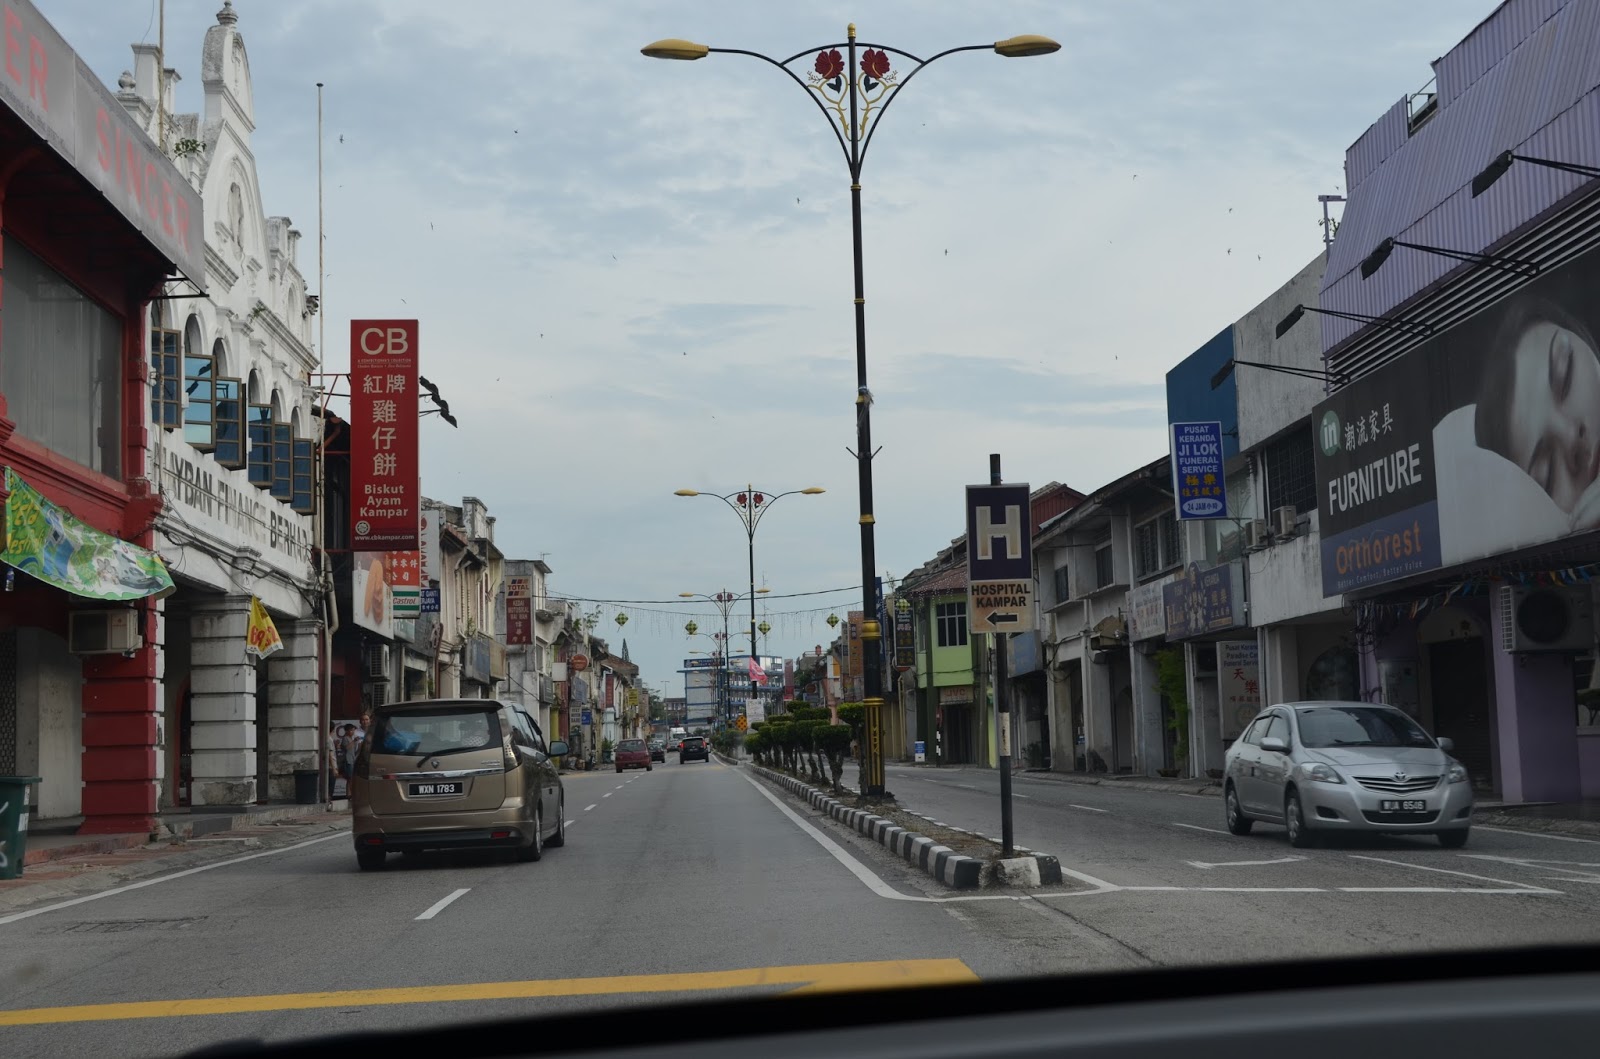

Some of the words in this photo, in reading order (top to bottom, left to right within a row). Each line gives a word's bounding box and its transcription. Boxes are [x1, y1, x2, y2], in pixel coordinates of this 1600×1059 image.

[95, 106, 191, 254] SINGER
[360, 327, 409, 356] CB
[363, 374, 406, 394] 紅牌
[1184, 425, 1209, 434] PUSAT
[1344, 402, 1394, 452] 潮流家具
[1179, 434, 1216, 443] KERANDA
[1178, 444, 1190, 456] JI
[1193, 443, 1219, 456] LOK
[1179, 456, 1219, 465] FUNERAL
[1182, 465, 1218, 474] SERVICE
[1328, 442, 1422, 516] FURNITURE
[364, 484, 404, 494] Biskut
[366, 496, 401, 508] Ayam
[1187, 502, 1194, 511] 24
[359, 507, 409, 519] Kampar
[975, 504, 1022, 560] H
[971, 583, 1031, 596] HOSPITAL
[393, 597, 416, 605] Castrol
[976, 596, 1027, 609] KAMPAR
[418, 784, 434, 794] WXN
[436, 784, 455, 793] 1783
